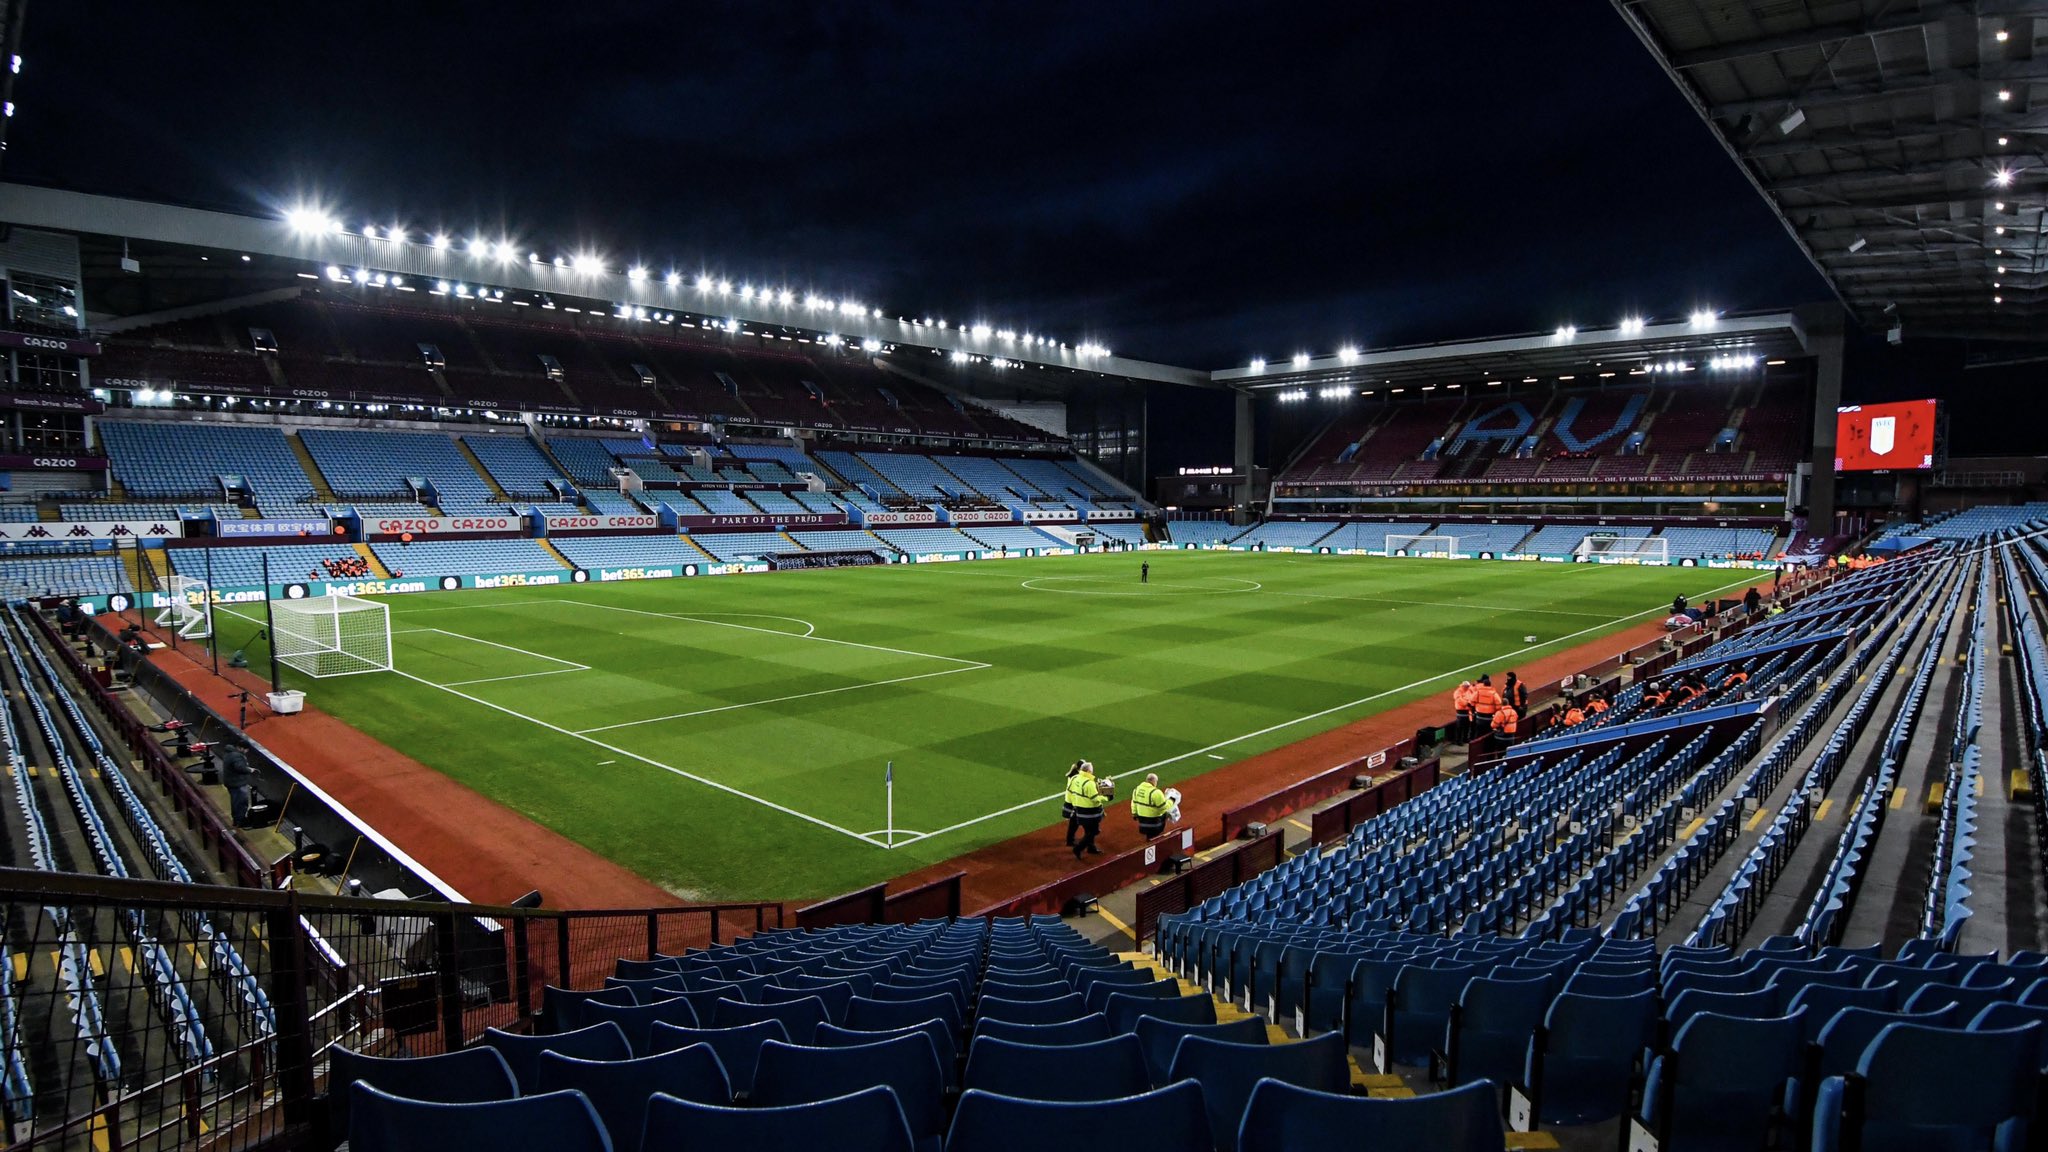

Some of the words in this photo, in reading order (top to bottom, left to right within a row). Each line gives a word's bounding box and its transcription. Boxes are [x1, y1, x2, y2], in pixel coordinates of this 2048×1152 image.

[23, 337, 68, 350] CAZOO
[105, 378, 148, 387] CAZOO
[293, 389, 329, 398] CAZOO
[468, 399, 498, 408] CAZOO
[33, 458, 77, 468] CAZOO
[722, 516, 748, 524] PART
[752, 516, 766, 524] OF
[770, 516, 790, 524] THE
[867, 514, 898, 522] CAZOO
[903, 513, 933, 522] CAZOO
[952, 513, 979, 521] CAZOO
[983, 512, 1009, 520] CAZOO
[379, 519, 439, 531] CAZOO
[452, 519, 508, 529] CAZOO
[549, 518, 599, 528] CAZOO
[608, 517, 654, 526] CAZOO
[916, 553, 960, 563] bet365.com
[708, 563, 769, 575] bet365.com
[601, 568, 673, 581] bet365.com
[475, 574, 559, 588] bet365.com
[325, 581, 425, 596] bet365.com
